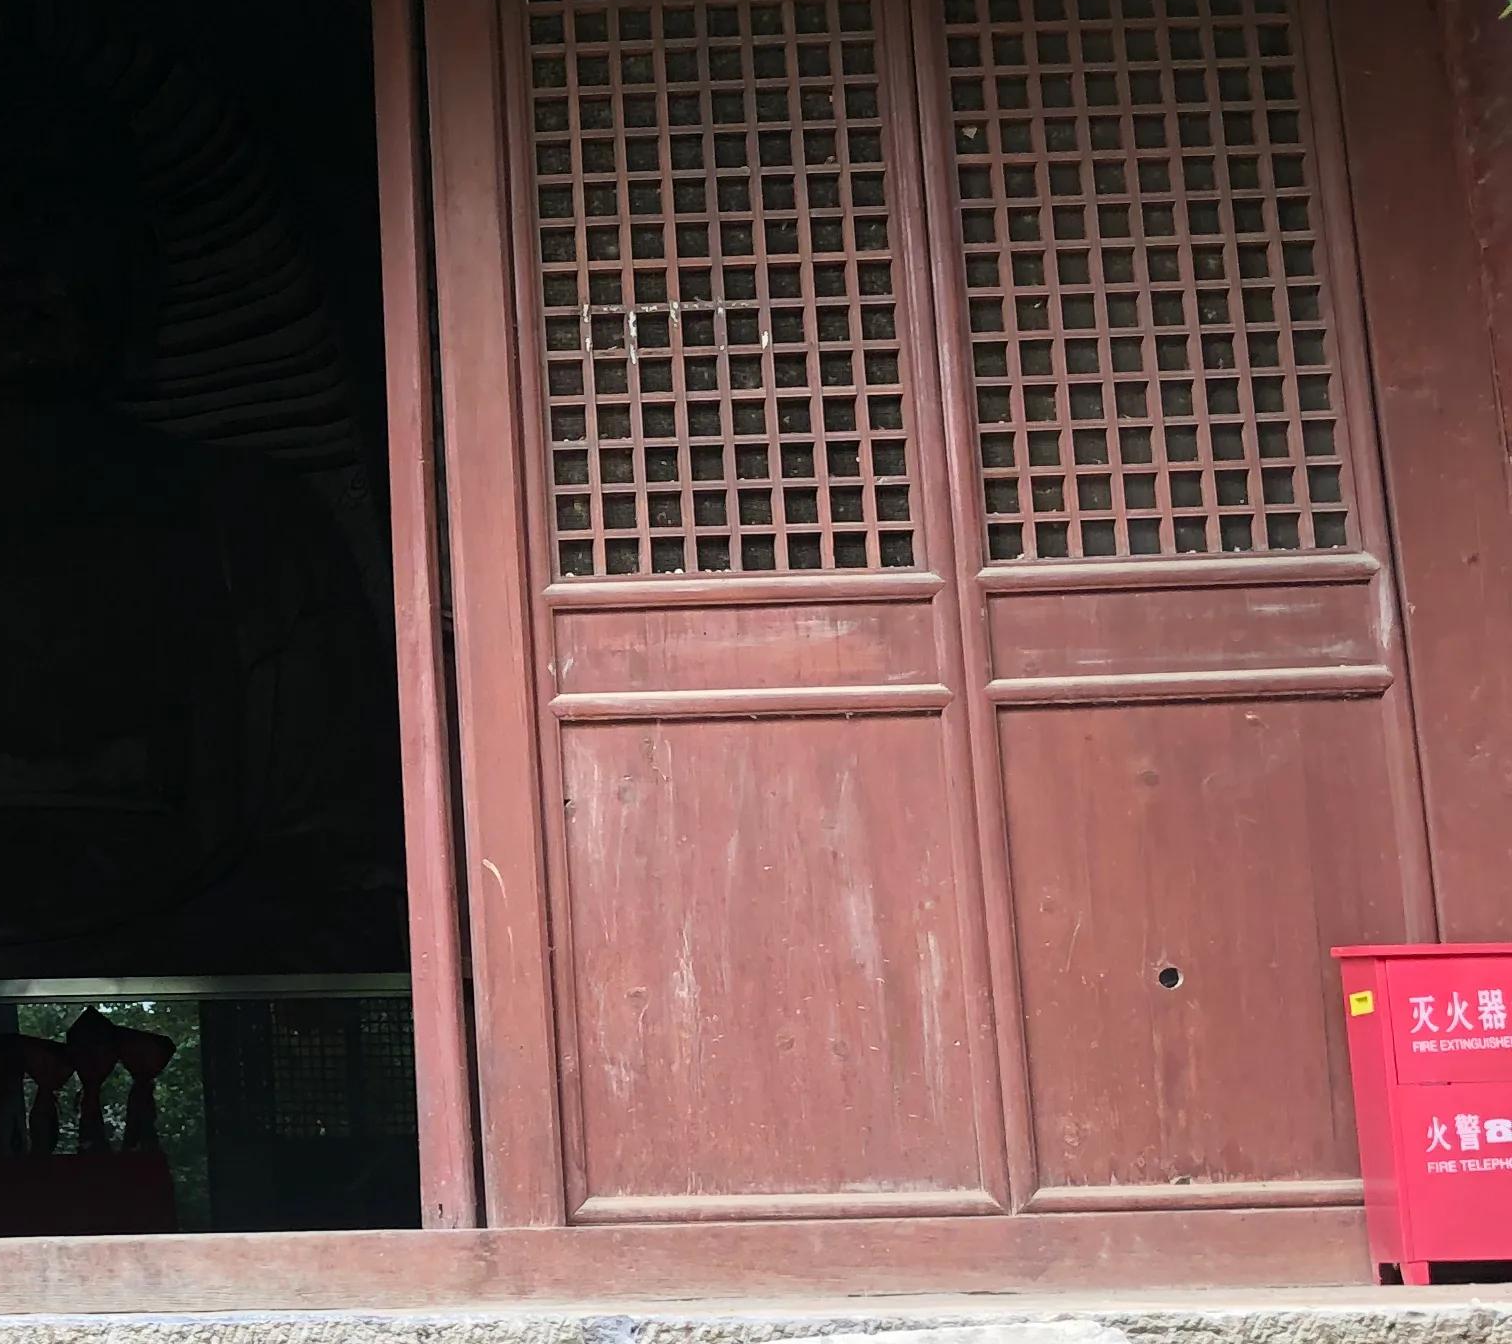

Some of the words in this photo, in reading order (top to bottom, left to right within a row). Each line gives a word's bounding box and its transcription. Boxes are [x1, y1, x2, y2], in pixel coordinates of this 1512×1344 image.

[1408, 989, 1507, 1034] 灭火器
[1412, 1039, 1438, 1053] FIRE
[1426, 1114, 1481, 1153] 火警
[1427, 1160, 1458, 1173] FIRE
